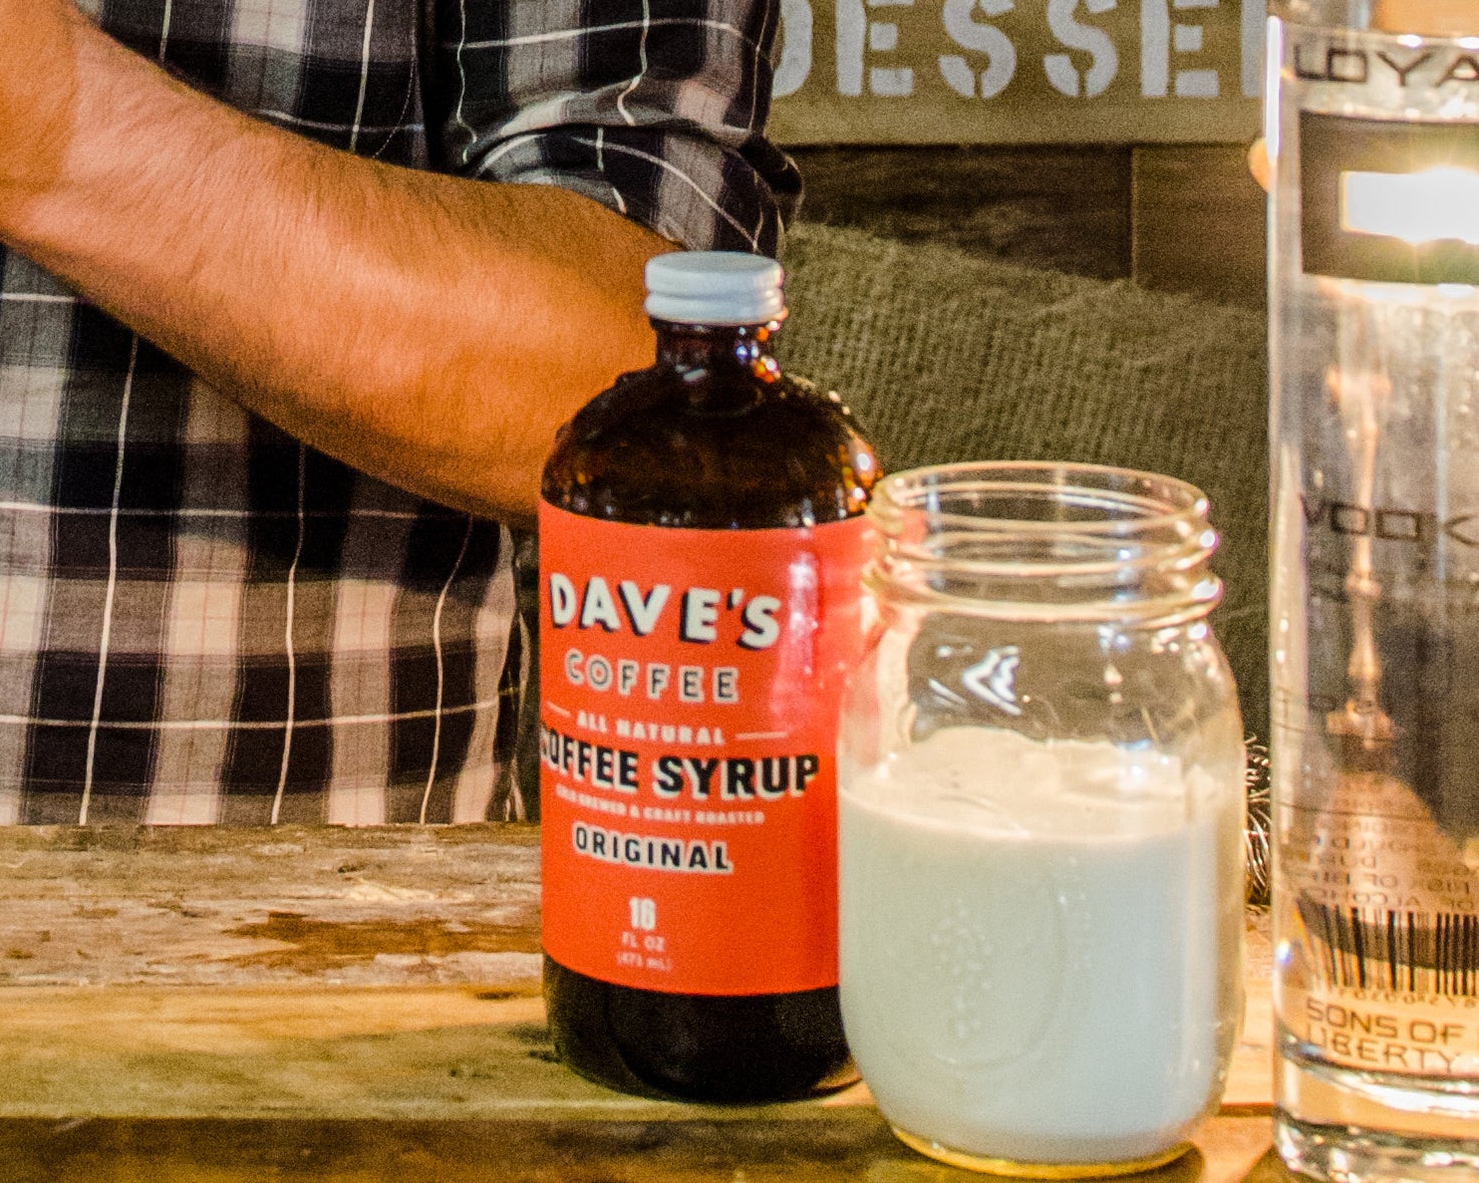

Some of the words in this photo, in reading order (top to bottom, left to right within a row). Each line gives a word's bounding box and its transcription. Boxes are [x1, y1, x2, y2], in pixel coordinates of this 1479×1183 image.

[1293, 43, 1479, 89] LOYA
[549, 572, 781, 650] DAVE'S
[564, 648, 739, 704] COFFEE
[577, 709, 608, 734] ALL
[615, 718, 726, 747] NATURAL
[651, 754, 820, 801] SYRUP
[572, 821, 735, 875] ORIGINAL
[1306, 997, 1399, 1039] SONS
[1408, 1019, 1465, 1044] OF
